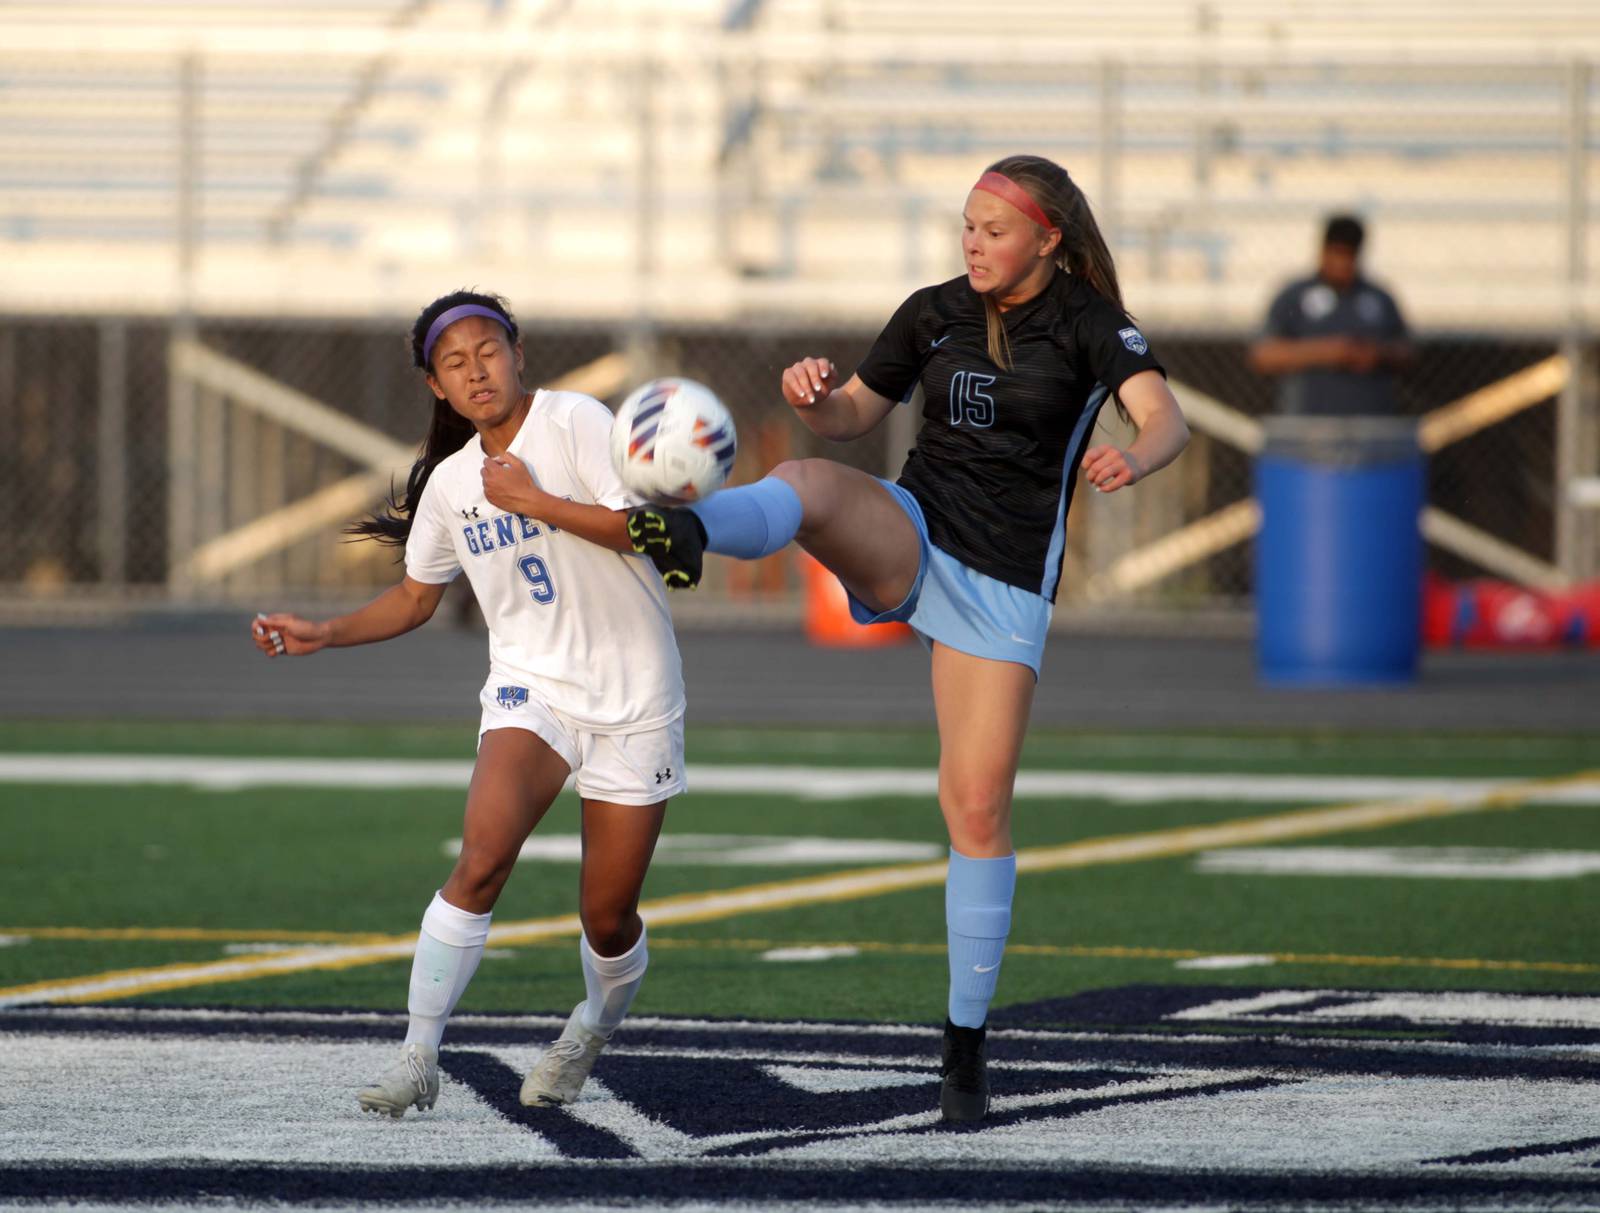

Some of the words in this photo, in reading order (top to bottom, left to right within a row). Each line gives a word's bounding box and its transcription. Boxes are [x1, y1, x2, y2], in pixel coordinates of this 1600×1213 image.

[950, 370, 996, 428] 15
[463, 496, 576, 556] GENE
[517, 553, 557, 605] 9
